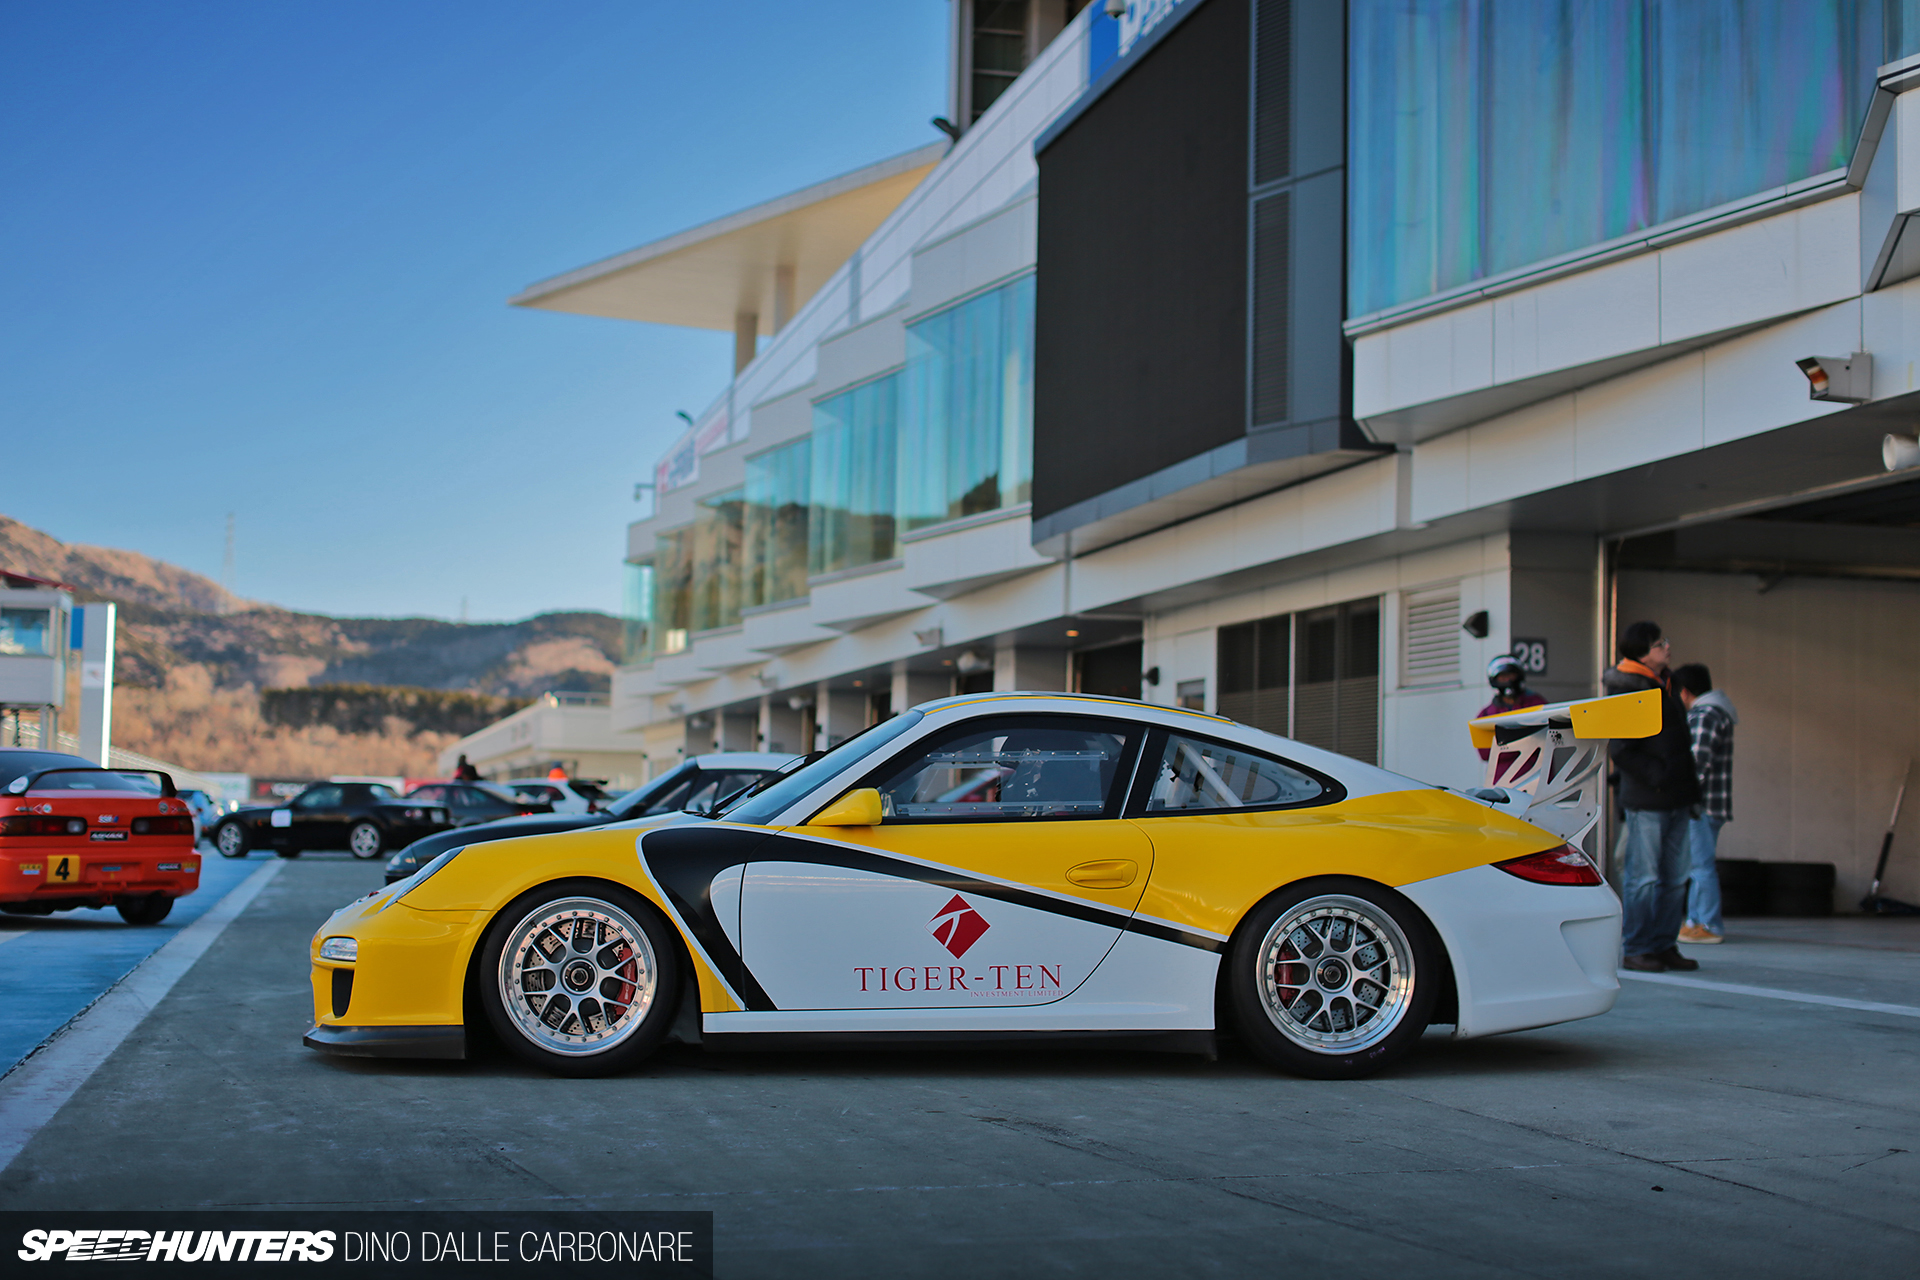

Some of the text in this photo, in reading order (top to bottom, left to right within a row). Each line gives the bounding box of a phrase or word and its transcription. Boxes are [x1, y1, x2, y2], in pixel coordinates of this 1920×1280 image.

[1514, 642, 1546, 672] 28
[55, 857, 70, 881] 4
[853, 964, 1062, 992] TIGER-TEN
[970, 989, 1064, 998] INVESTMENT LIMITED
